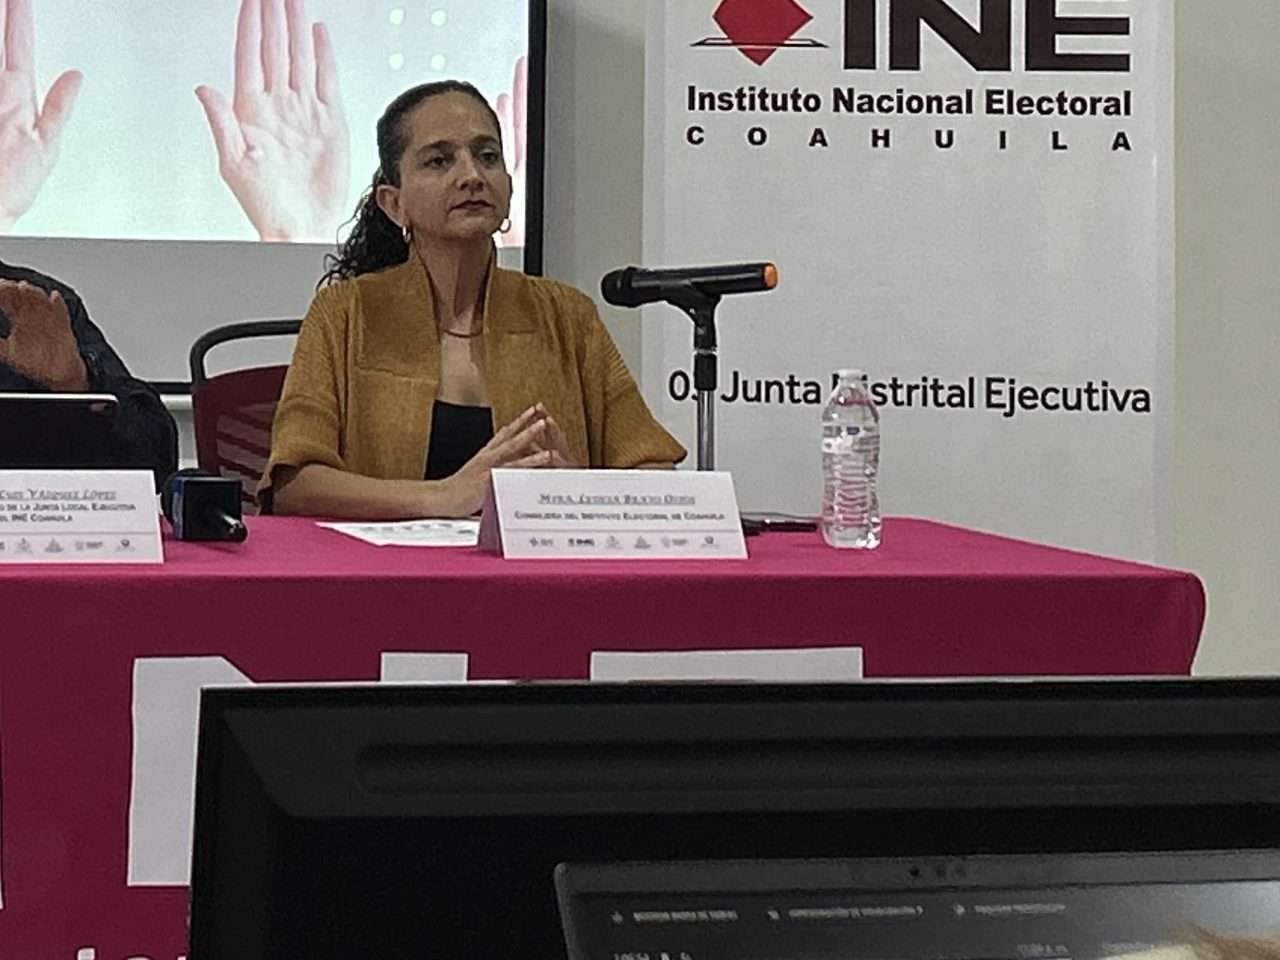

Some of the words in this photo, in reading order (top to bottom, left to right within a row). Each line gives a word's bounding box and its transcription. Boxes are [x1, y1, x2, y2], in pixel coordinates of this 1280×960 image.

[686, 86, 822, 113] Instituto
[832, 88, 973, 116] Nacional
[984, 89, 1132, 117] Electoral
[686, 125, 1132, 152] COAHUILA
[721, 371, 821, 404] Junta
[831, 373, 975, 408] strital
[984, 377, 1152, 418] Ejecutiva
